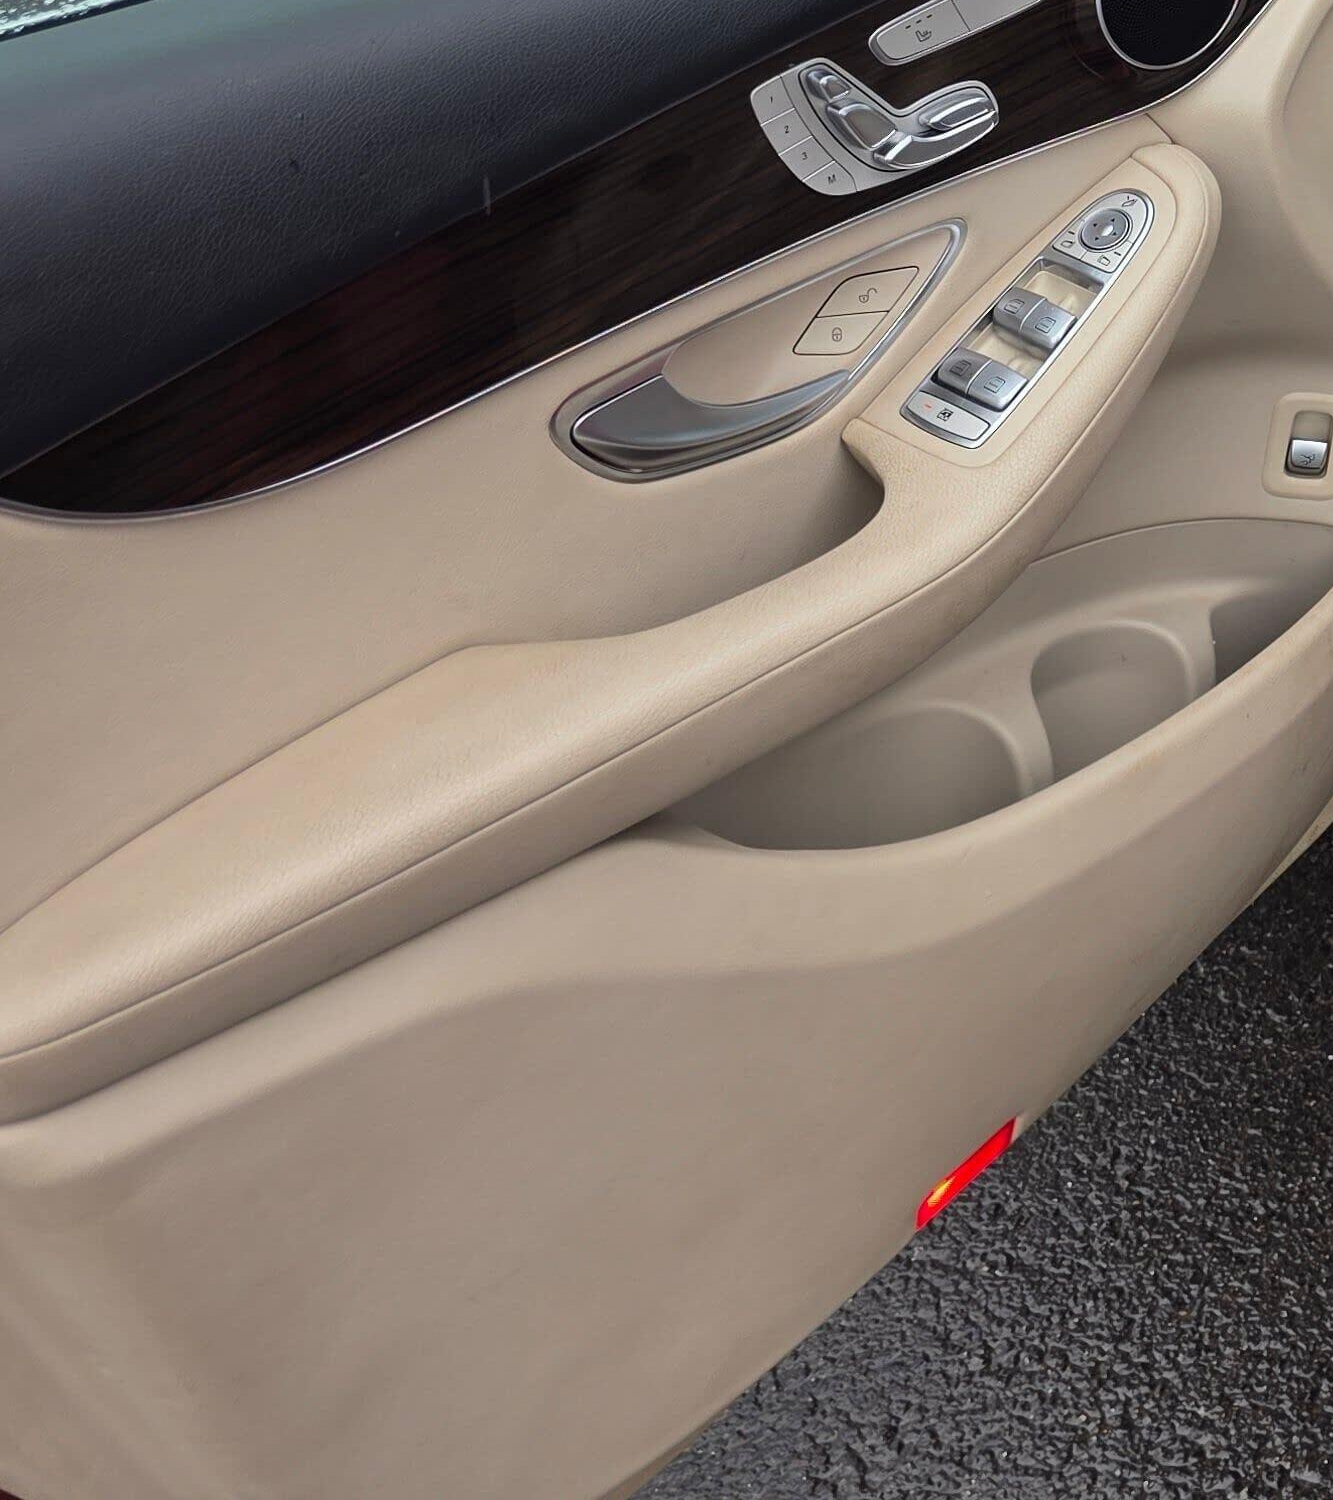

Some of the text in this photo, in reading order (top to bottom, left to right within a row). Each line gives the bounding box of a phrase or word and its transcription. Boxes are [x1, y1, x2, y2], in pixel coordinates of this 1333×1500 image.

[783, 125, 790, 134] 2
[801, 151, 808, 161] 3
[827, 174, 837, 184] M
